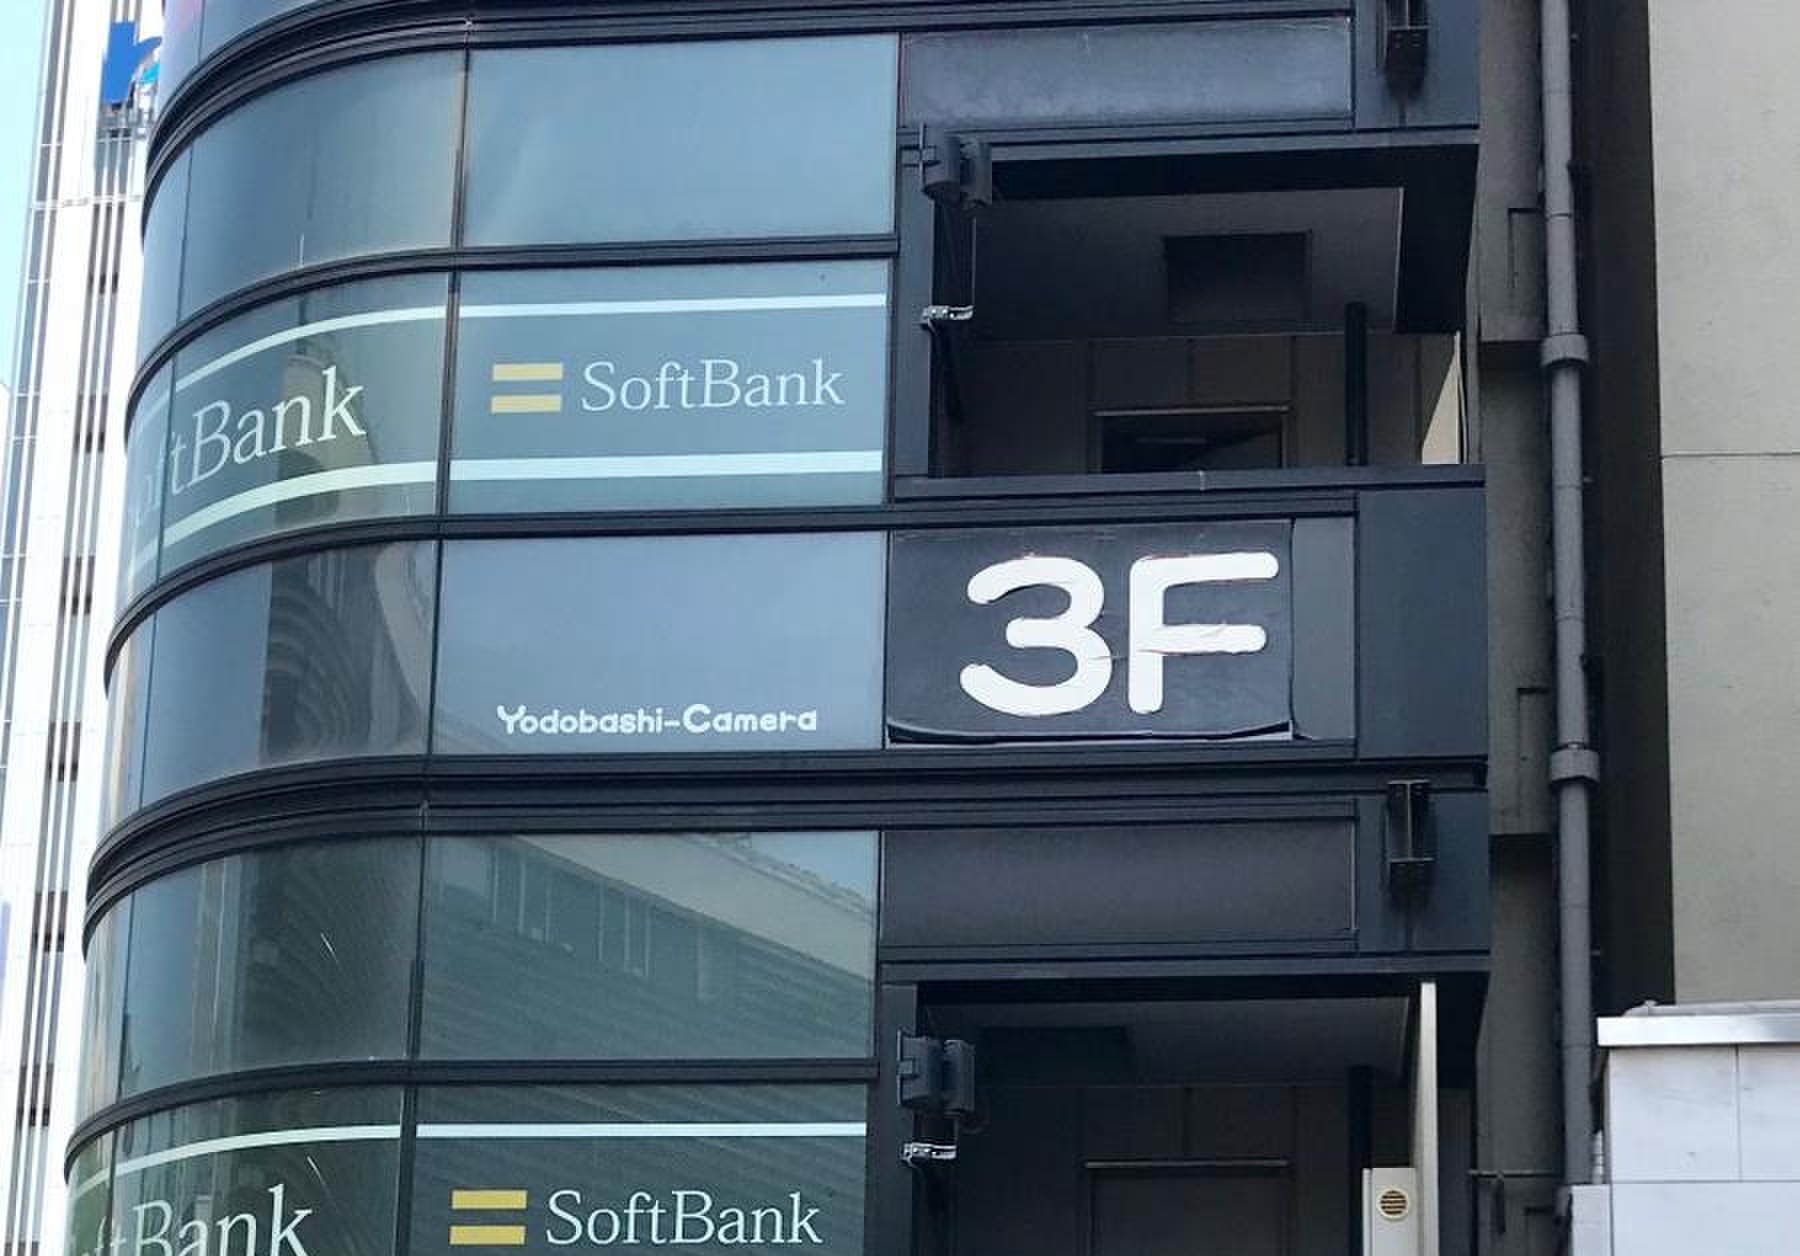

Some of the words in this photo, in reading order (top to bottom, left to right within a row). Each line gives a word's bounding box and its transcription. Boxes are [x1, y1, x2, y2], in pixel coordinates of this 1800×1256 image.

[580, 358, 845, 413] SoftBank
[960, 551, 1279, 718] 3F
[497, 704, 818, 736] Yodobashi-Camera
[545, 1190, 823, 1245] SoftBank
